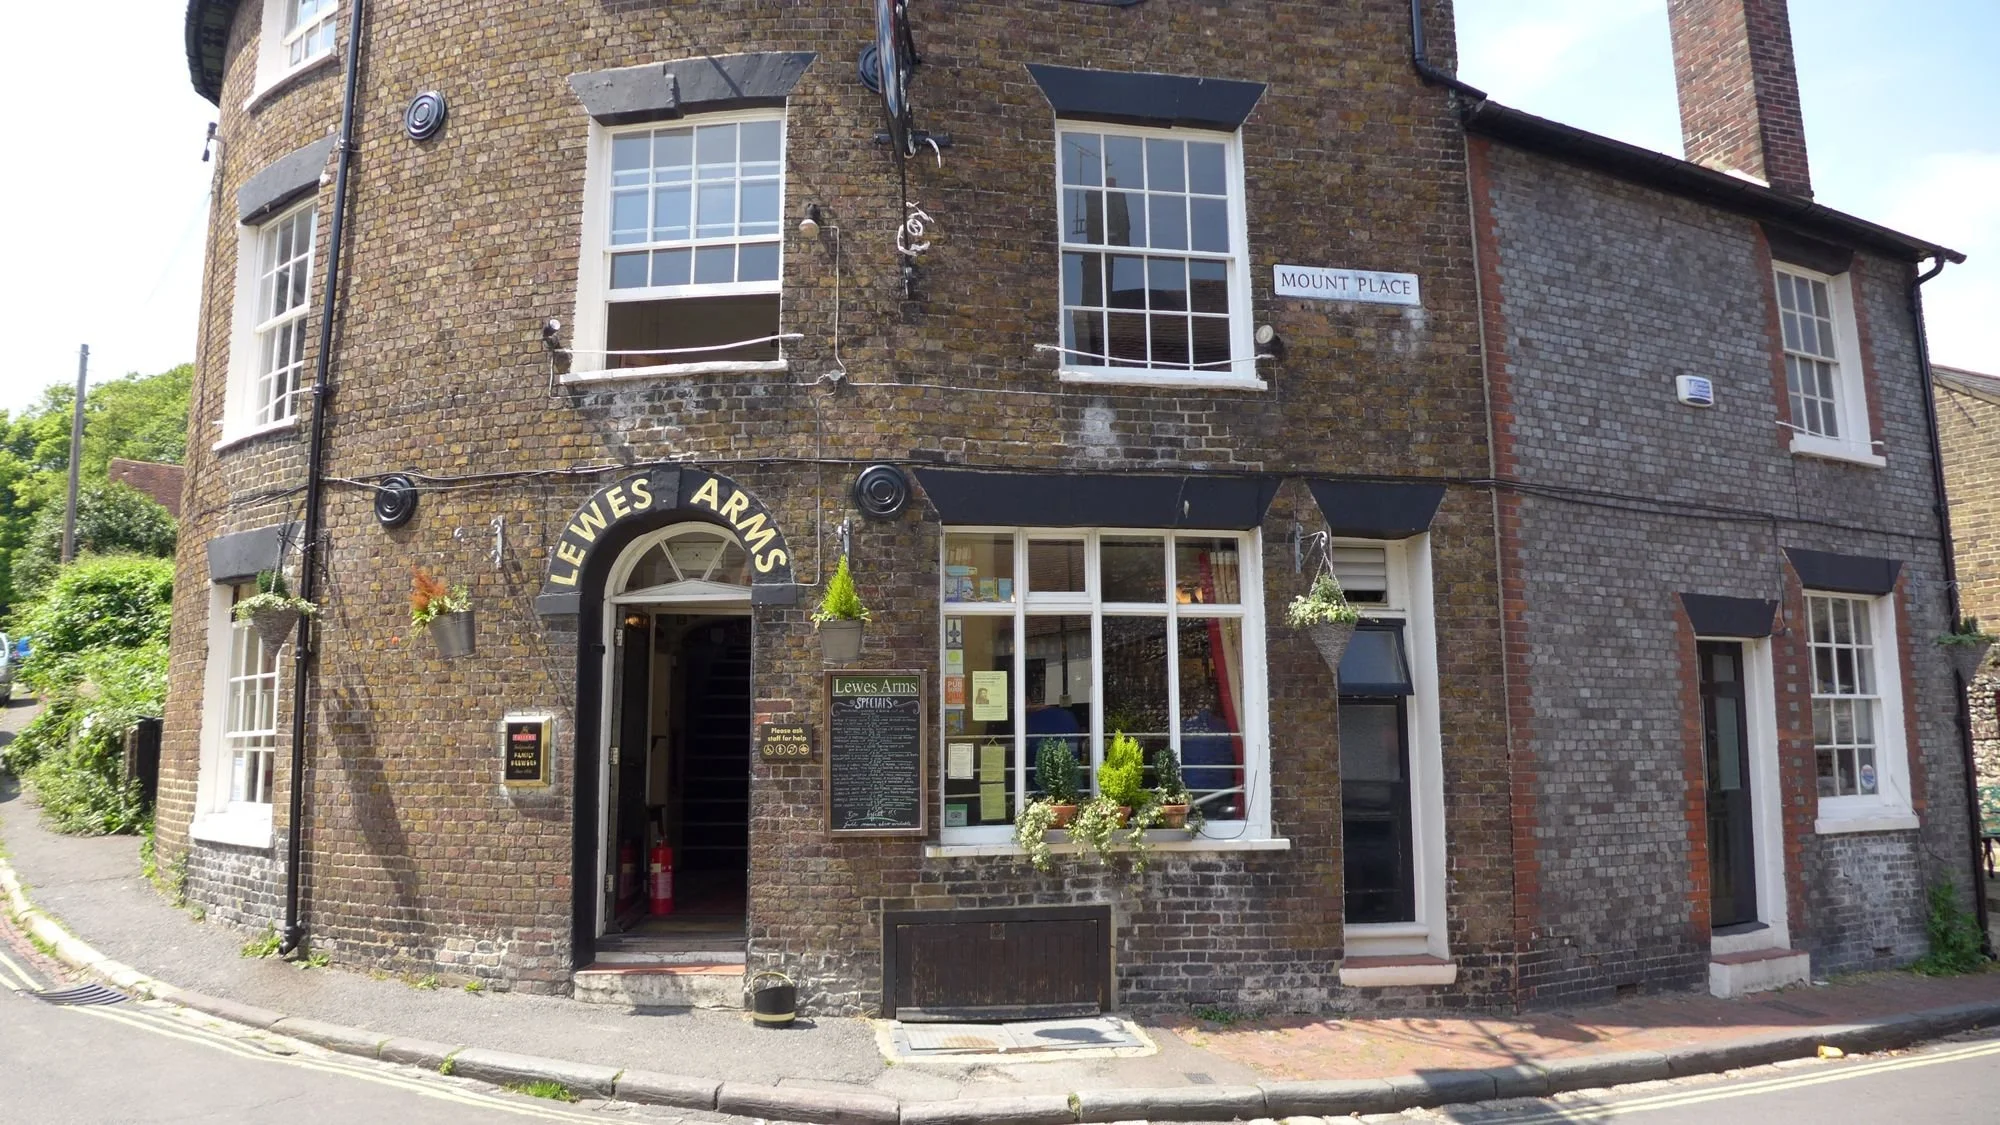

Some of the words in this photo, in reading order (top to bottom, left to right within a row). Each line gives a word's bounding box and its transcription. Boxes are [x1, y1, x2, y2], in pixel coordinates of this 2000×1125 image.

[1281, 272, 1349, 291] MOUNT
[1358, 277, 1411, 295] PLACE
[550, 478, 652, 587] LEWES
[690, 477, 787, 573] ARMS
[835, 678, 877, 693] Lewes
[880, 679, 917, 693] Arms
